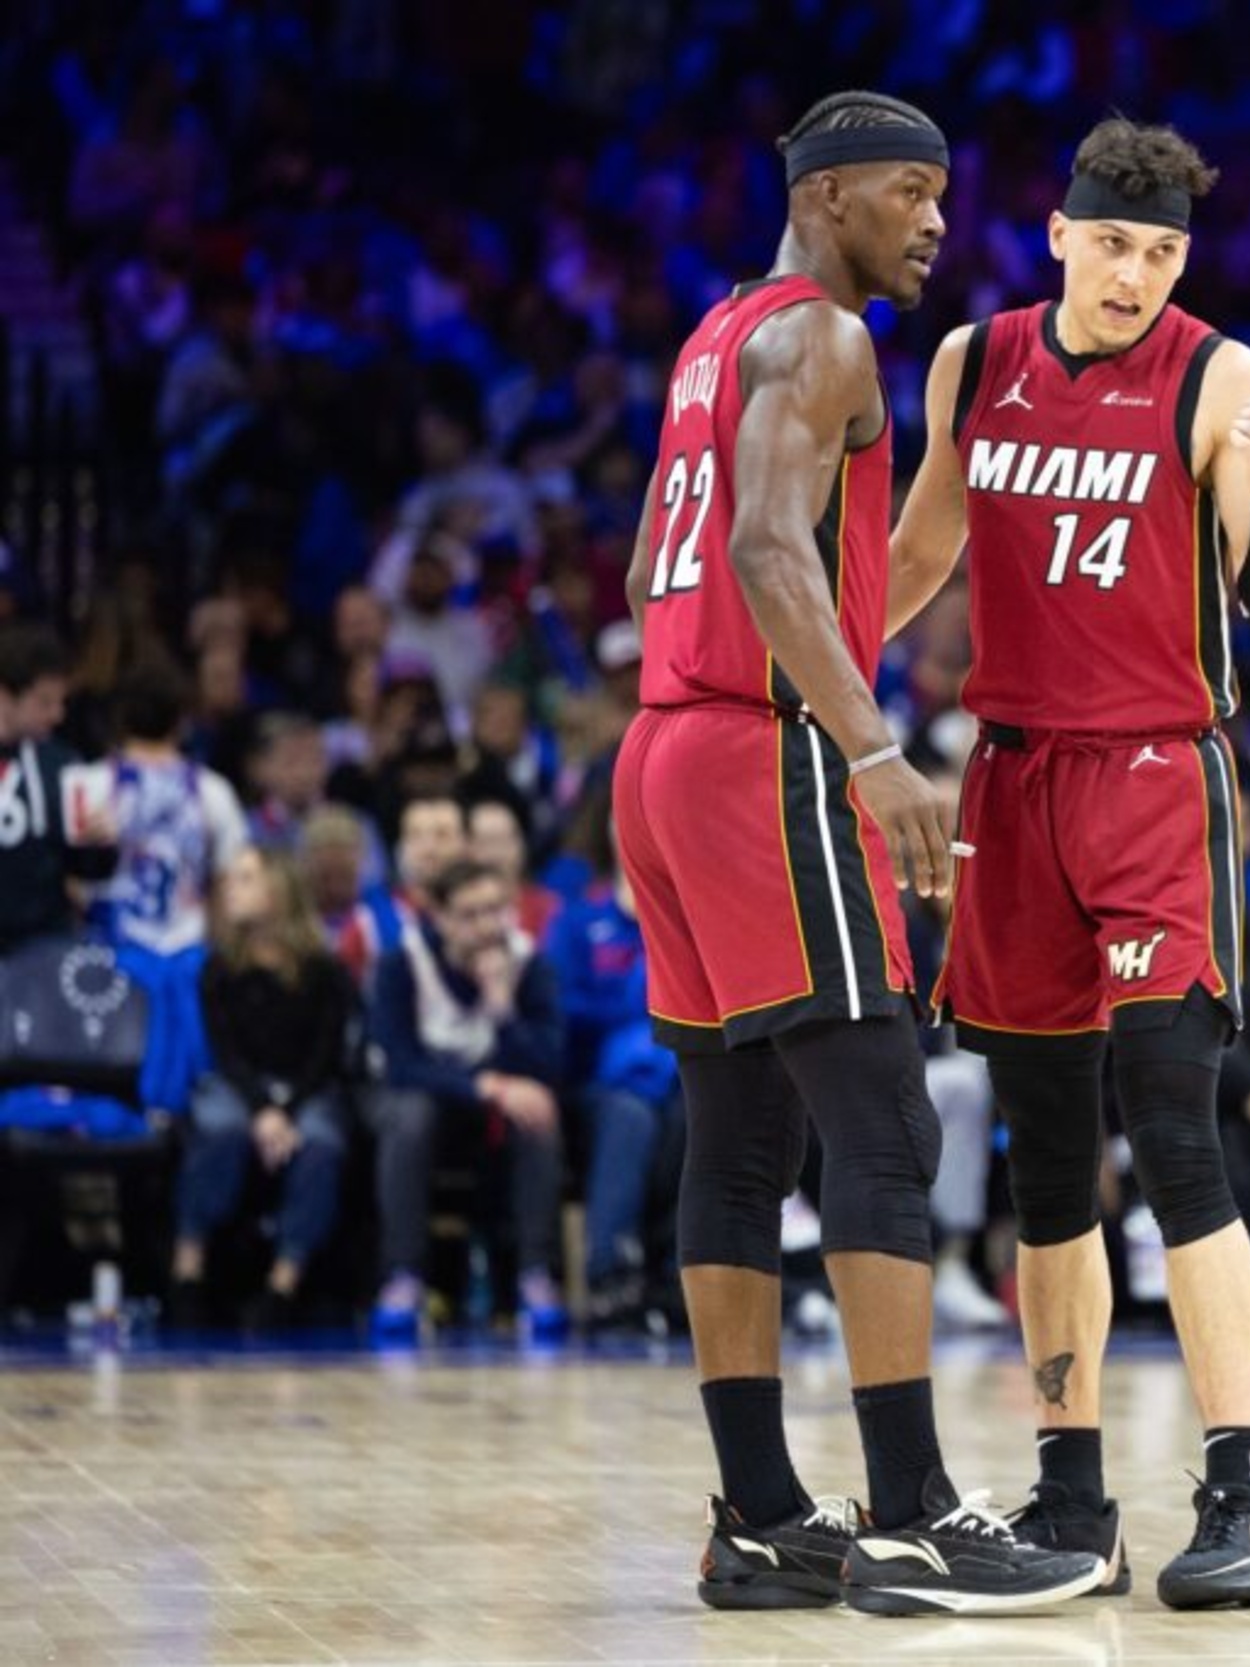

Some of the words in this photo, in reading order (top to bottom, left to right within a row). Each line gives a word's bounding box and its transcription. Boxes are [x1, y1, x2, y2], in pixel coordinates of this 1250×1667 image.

[967, 438, 1158, 504] MIAMI
[649, 449, 716, 600] 22
[1045, 512, 1132, 589] 14
